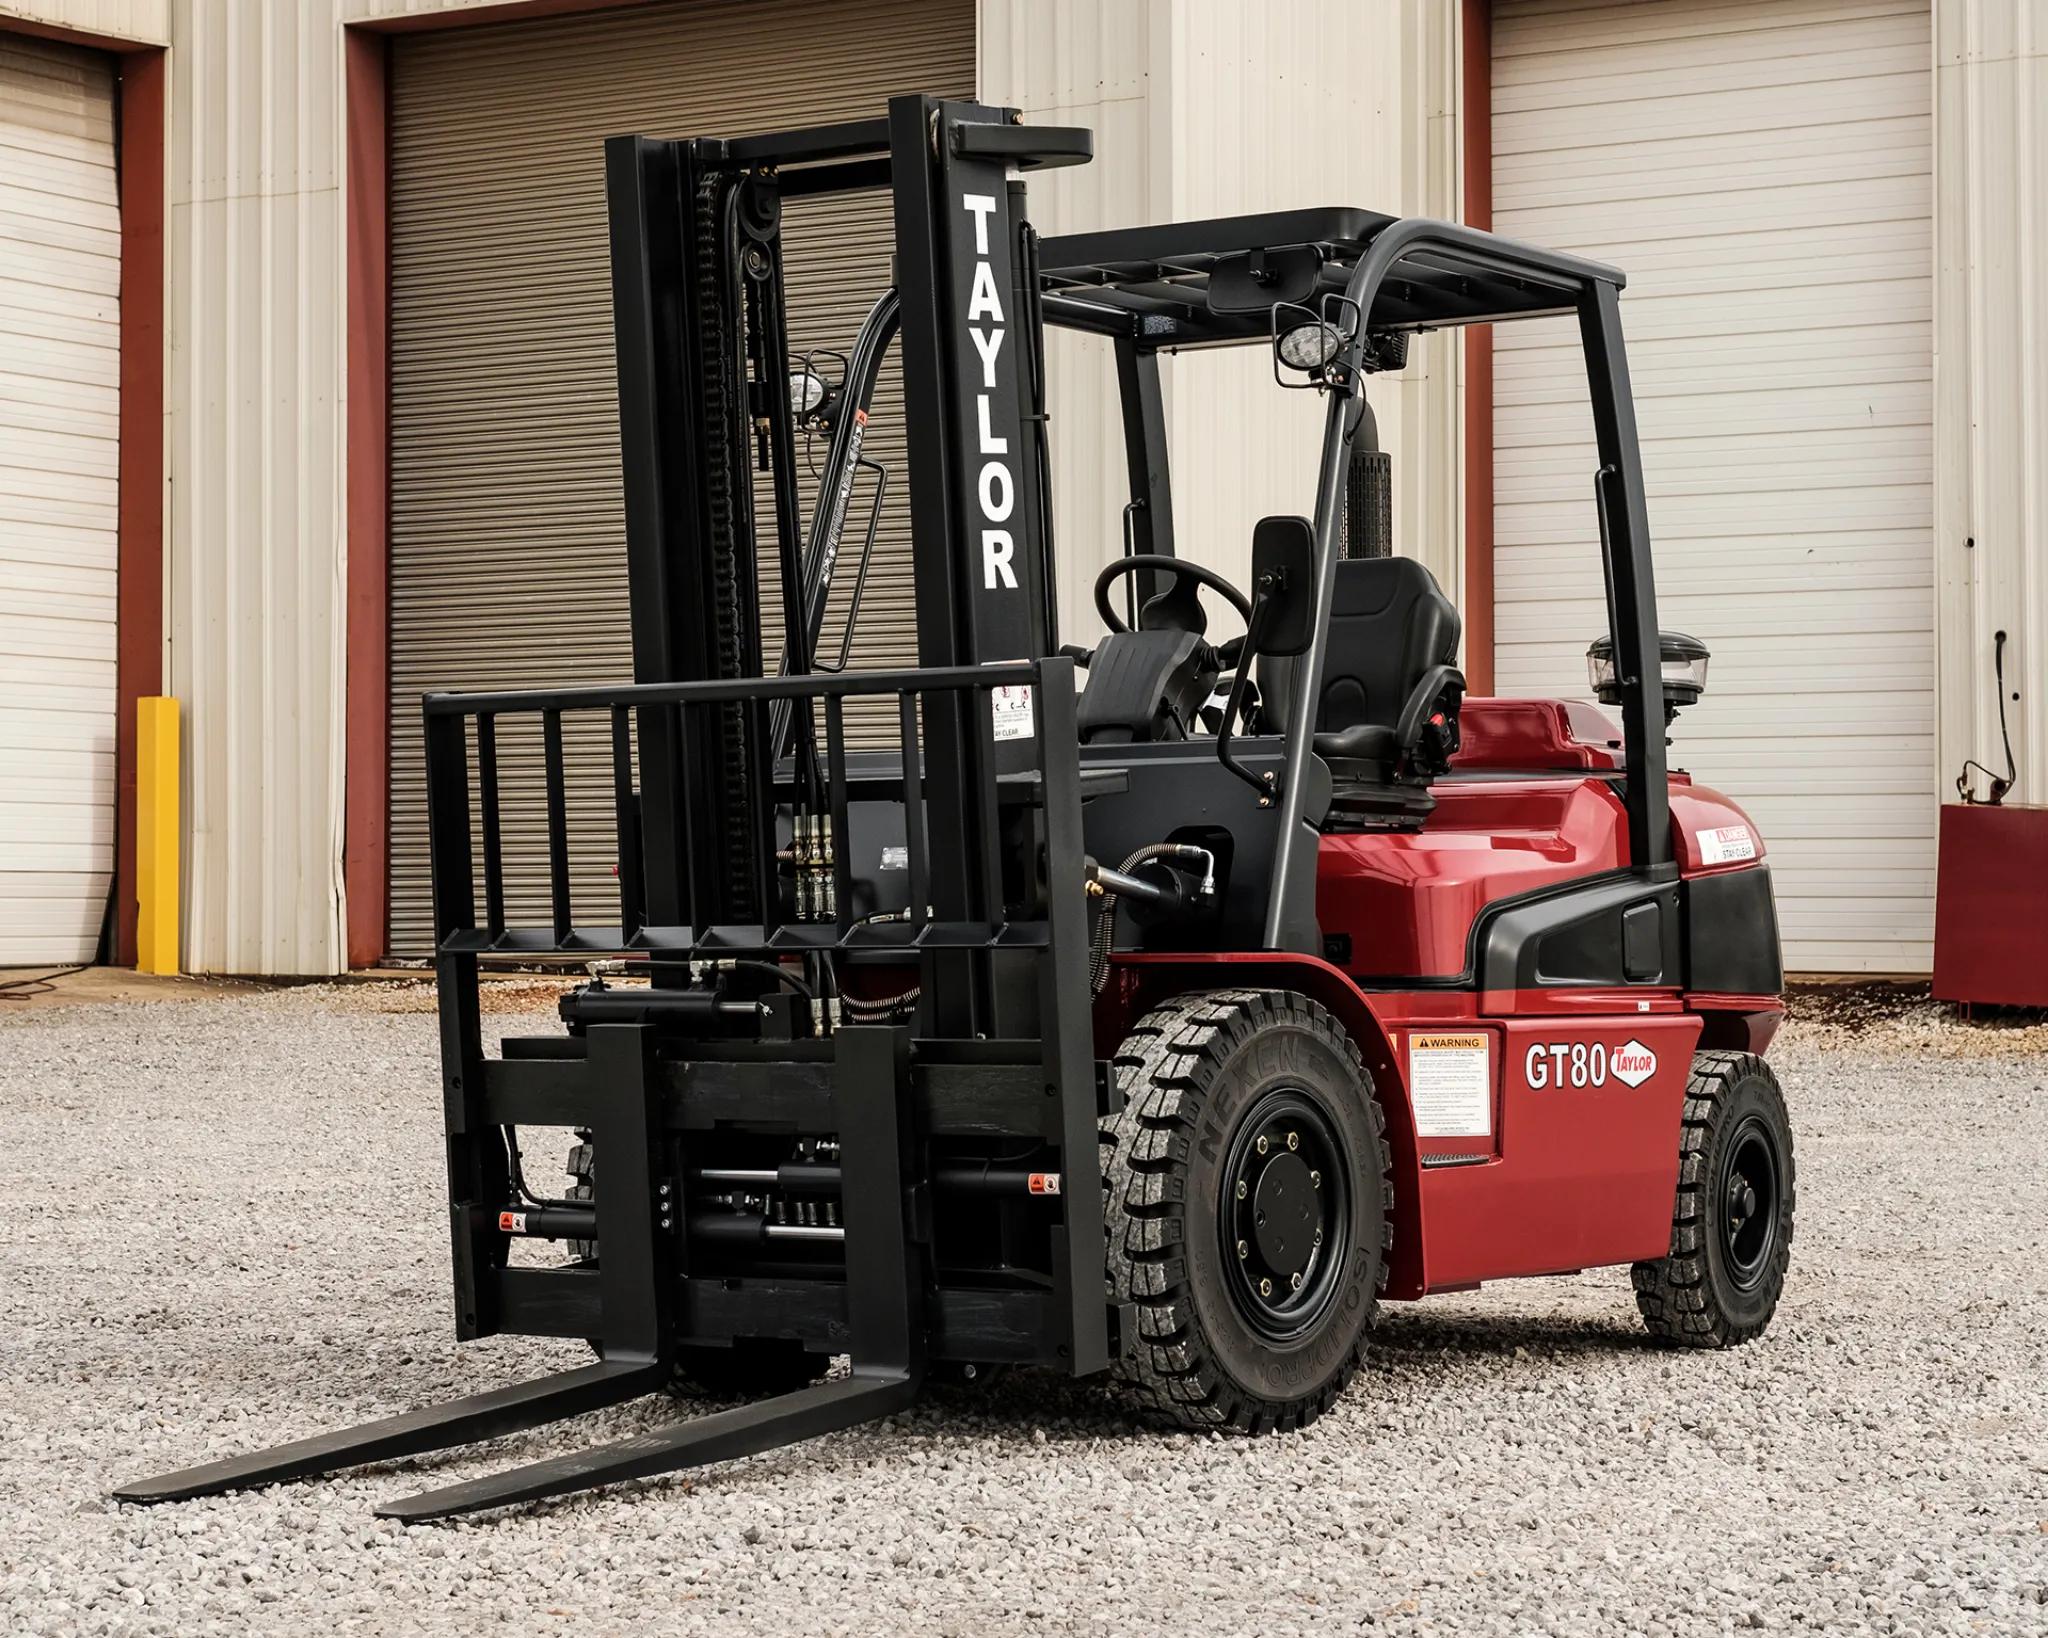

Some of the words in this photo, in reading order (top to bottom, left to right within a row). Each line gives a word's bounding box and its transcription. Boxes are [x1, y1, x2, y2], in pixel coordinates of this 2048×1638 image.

[963, 193, 1019, 590] TAYLOR
[1002, 728, 1018, 736] CLEAR
[1430, 1038, 1480, 1047] WARNING
[1525, 1041, 1607, 1090] GT80
[1615, 1048, 1652, 1072] TAYLOR
[1198, 1034, 1302, 1166] NEXEN
